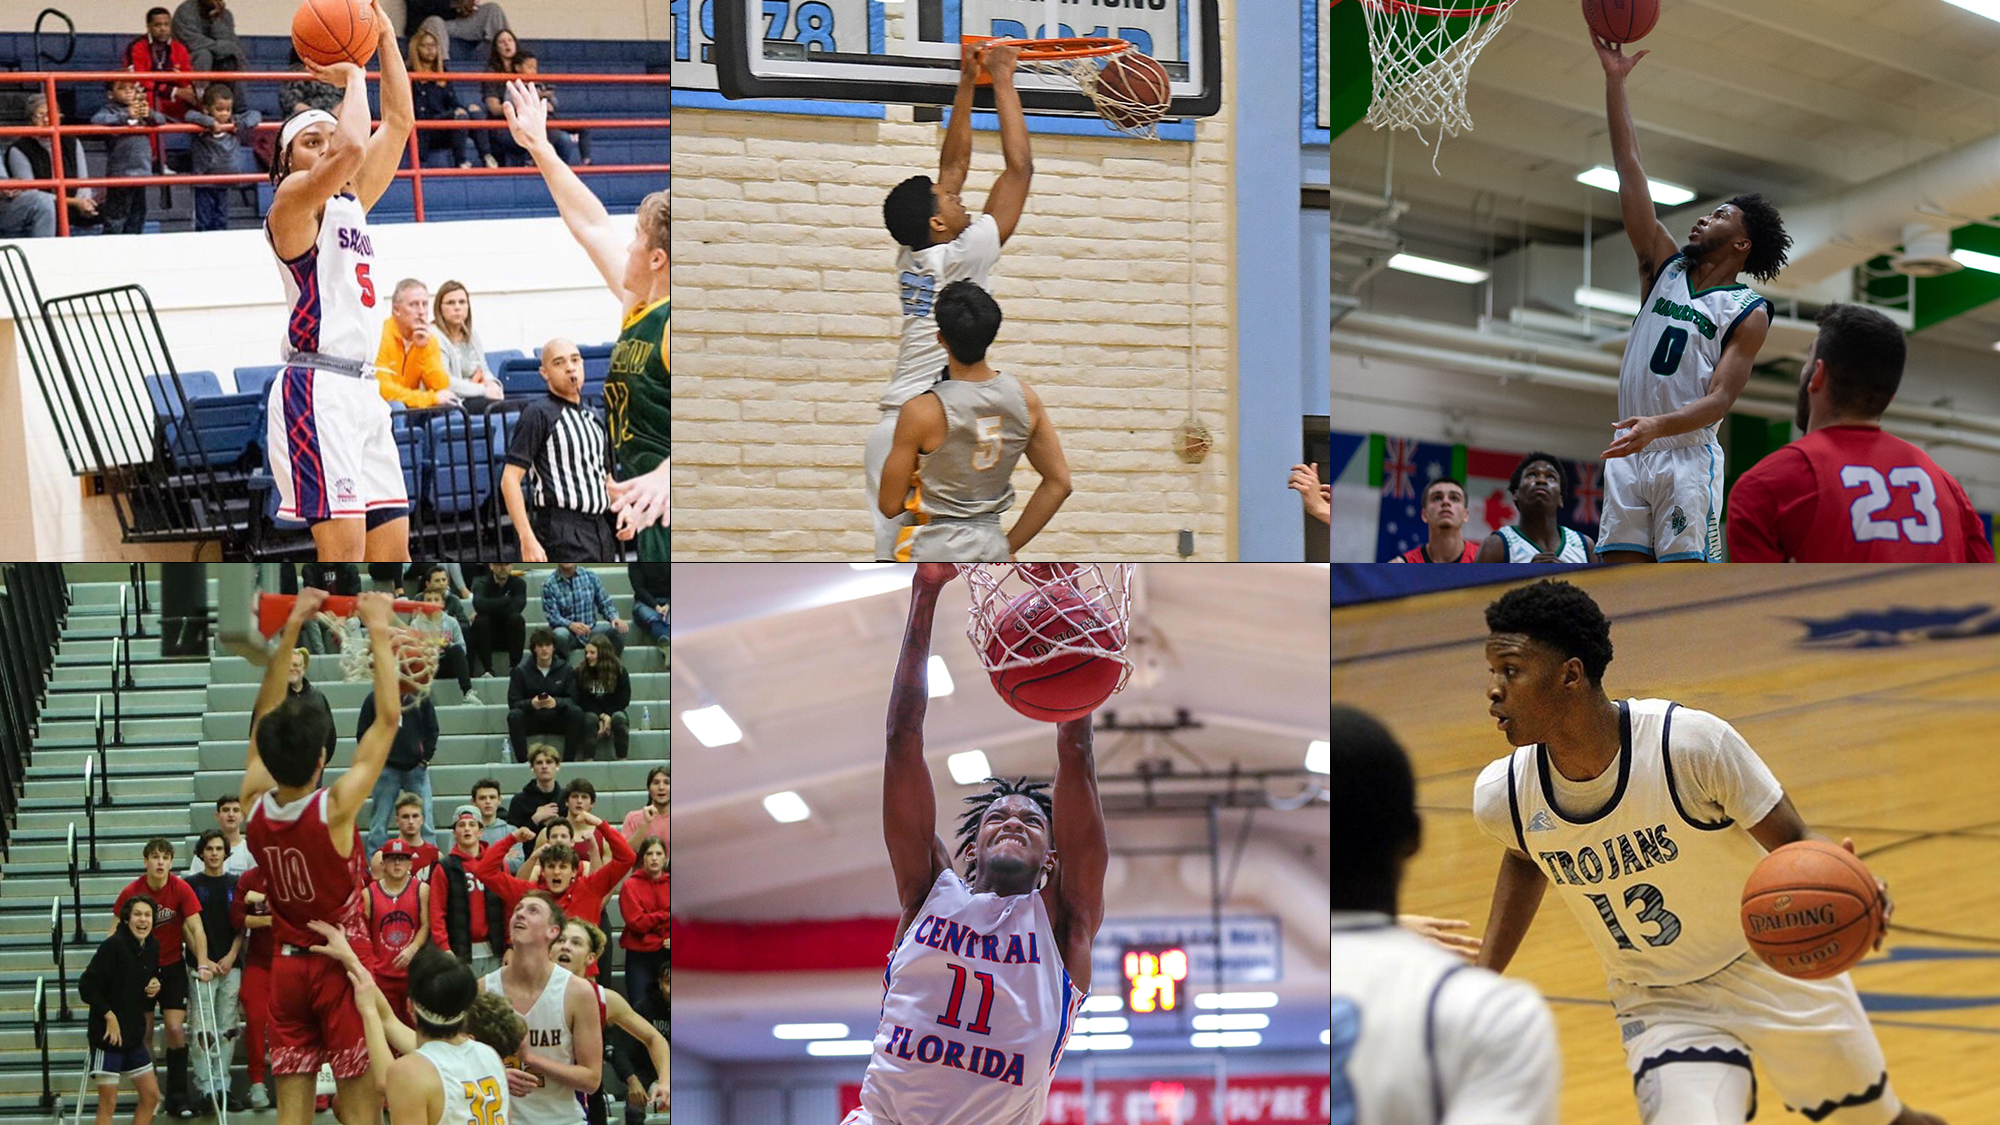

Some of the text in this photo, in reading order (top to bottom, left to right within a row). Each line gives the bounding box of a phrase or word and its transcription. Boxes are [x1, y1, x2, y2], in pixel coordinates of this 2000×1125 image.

[355, 262, 376, 309] 5
[1649, 324, 1689, 377] 0
[971, 415, 1003, 472] 5
[1838, 464, 1944, 545] 23
[263, 845, 316, 903] 10
[1538, 824, 1679, 886] TROJANS
[914, 914, 1042, 966] CENTRAL
[1583, 883, 1682, 953] 13
[1748, 903, 1835, 935] SPALDING
[936, 962, 995, 1036] 11
[884, 1024, 1025, 1087] FLORIDA
[461, 1075, 506, 1125] 32
